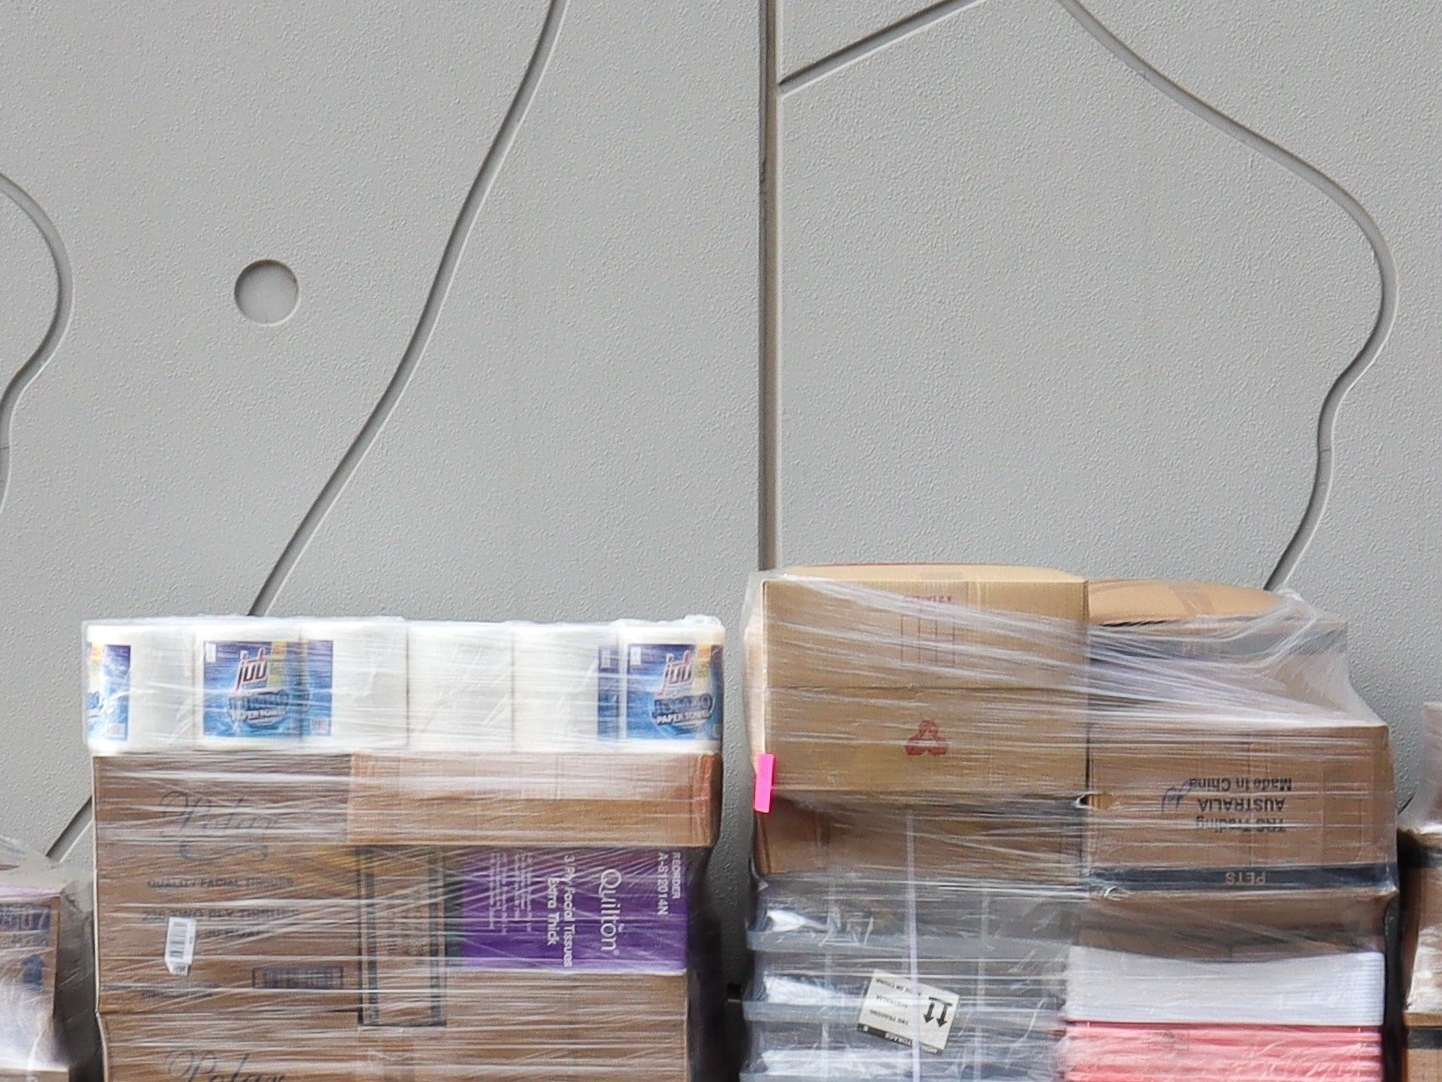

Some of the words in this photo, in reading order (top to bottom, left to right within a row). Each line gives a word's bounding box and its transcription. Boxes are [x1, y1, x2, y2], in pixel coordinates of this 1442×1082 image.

[1189, 777, 1231, 791] China
[1197, 798, 1286, 812] AUSTRALIA
[560, 866, 575, 885] Ply
[671, 852, 682, 899] REORDER
[1225, 871, 1266, 885] PETS
[546, 877, 560, 908] Extra
[563, 886, 575, 921] Facial
[598, 868, 623, 951] Quilton
[547, 912, 560, 946] Thick
[563, 925, 576, 968] Tissues
